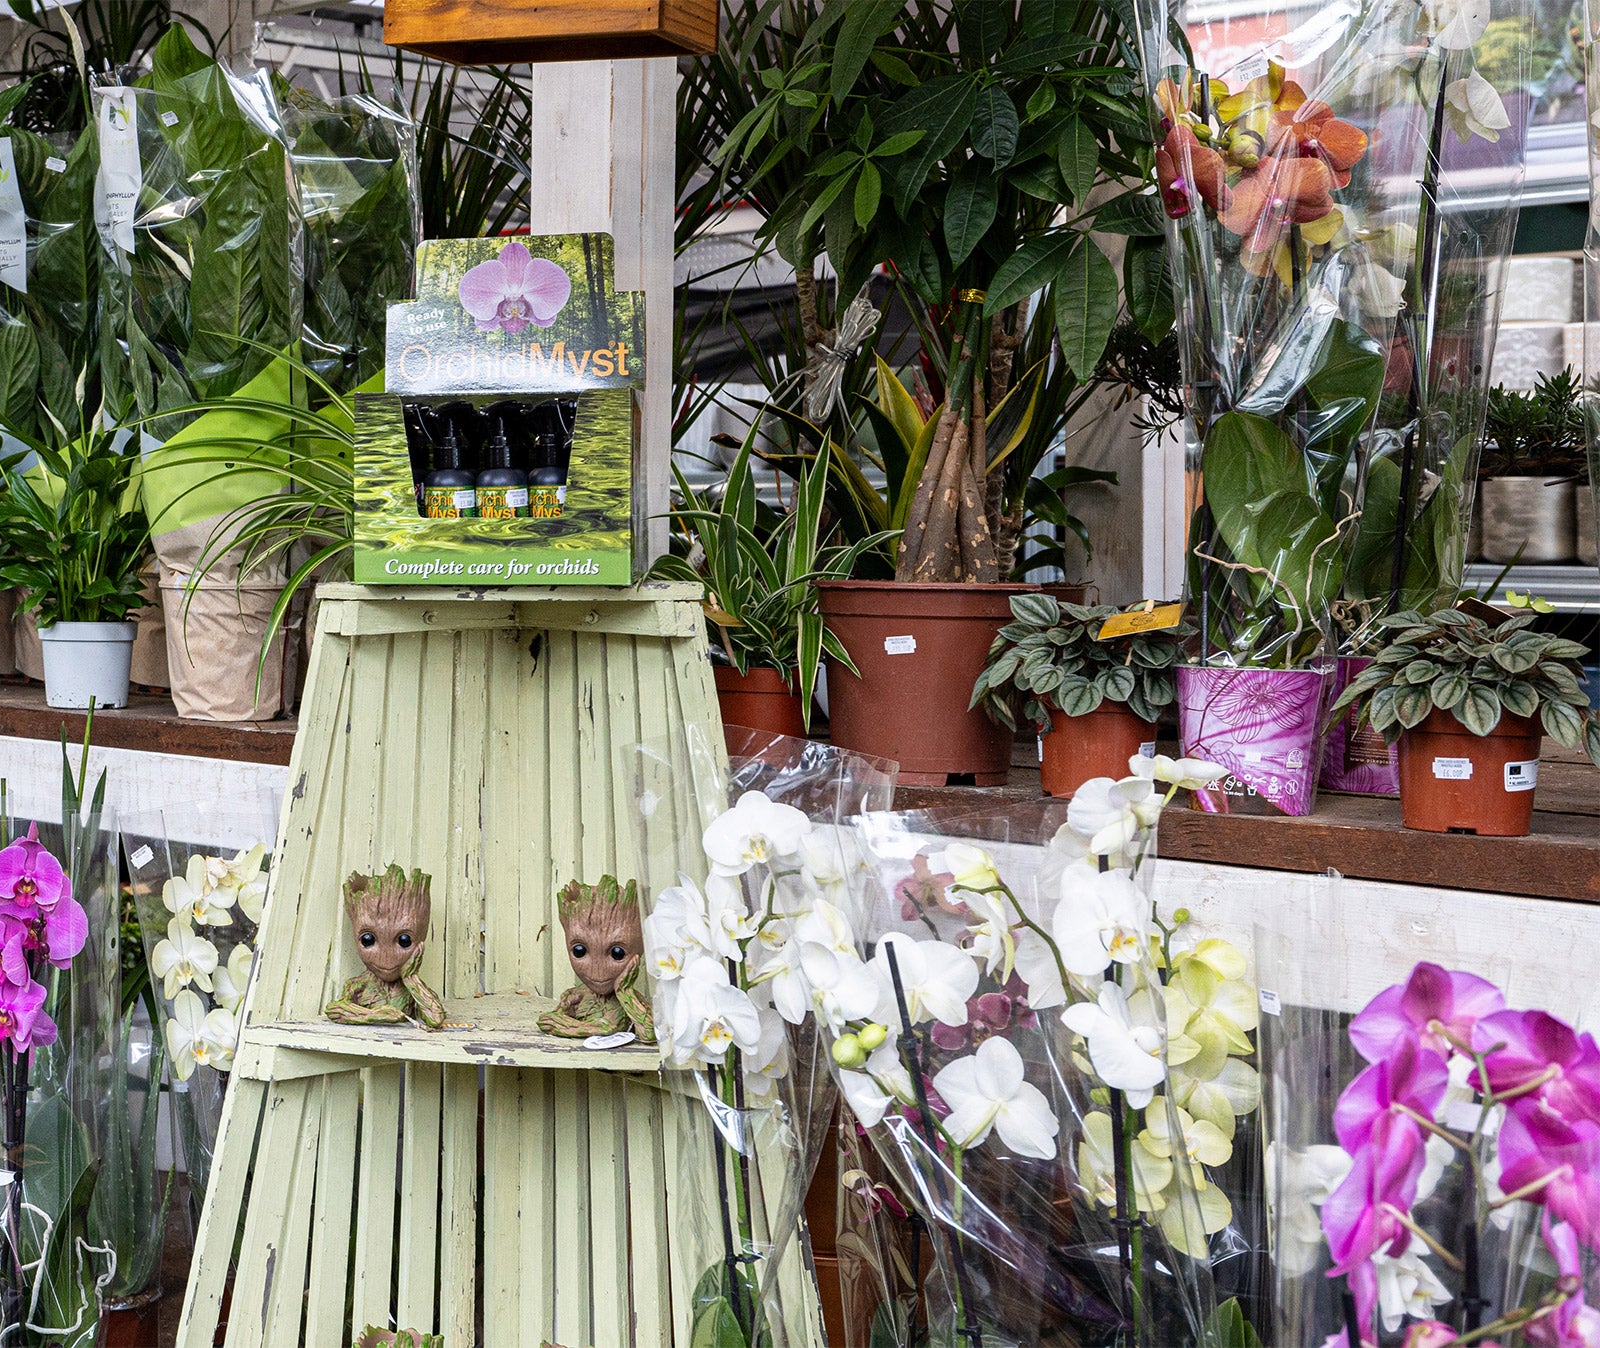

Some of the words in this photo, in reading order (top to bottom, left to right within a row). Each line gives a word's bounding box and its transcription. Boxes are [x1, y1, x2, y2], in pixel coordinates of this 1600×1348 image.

[407, 308, 446, 324] Ready
[410, 325, 423, 336] to
[425, 320, 448, 333] use
[400, 342, 630, 382] OrchidMyst
[384, 558, 463, 579] Complete
[467, 562, 504, 576] care
[504, 558, 533, 580] for
[536, 558, 600, 576] orchids
